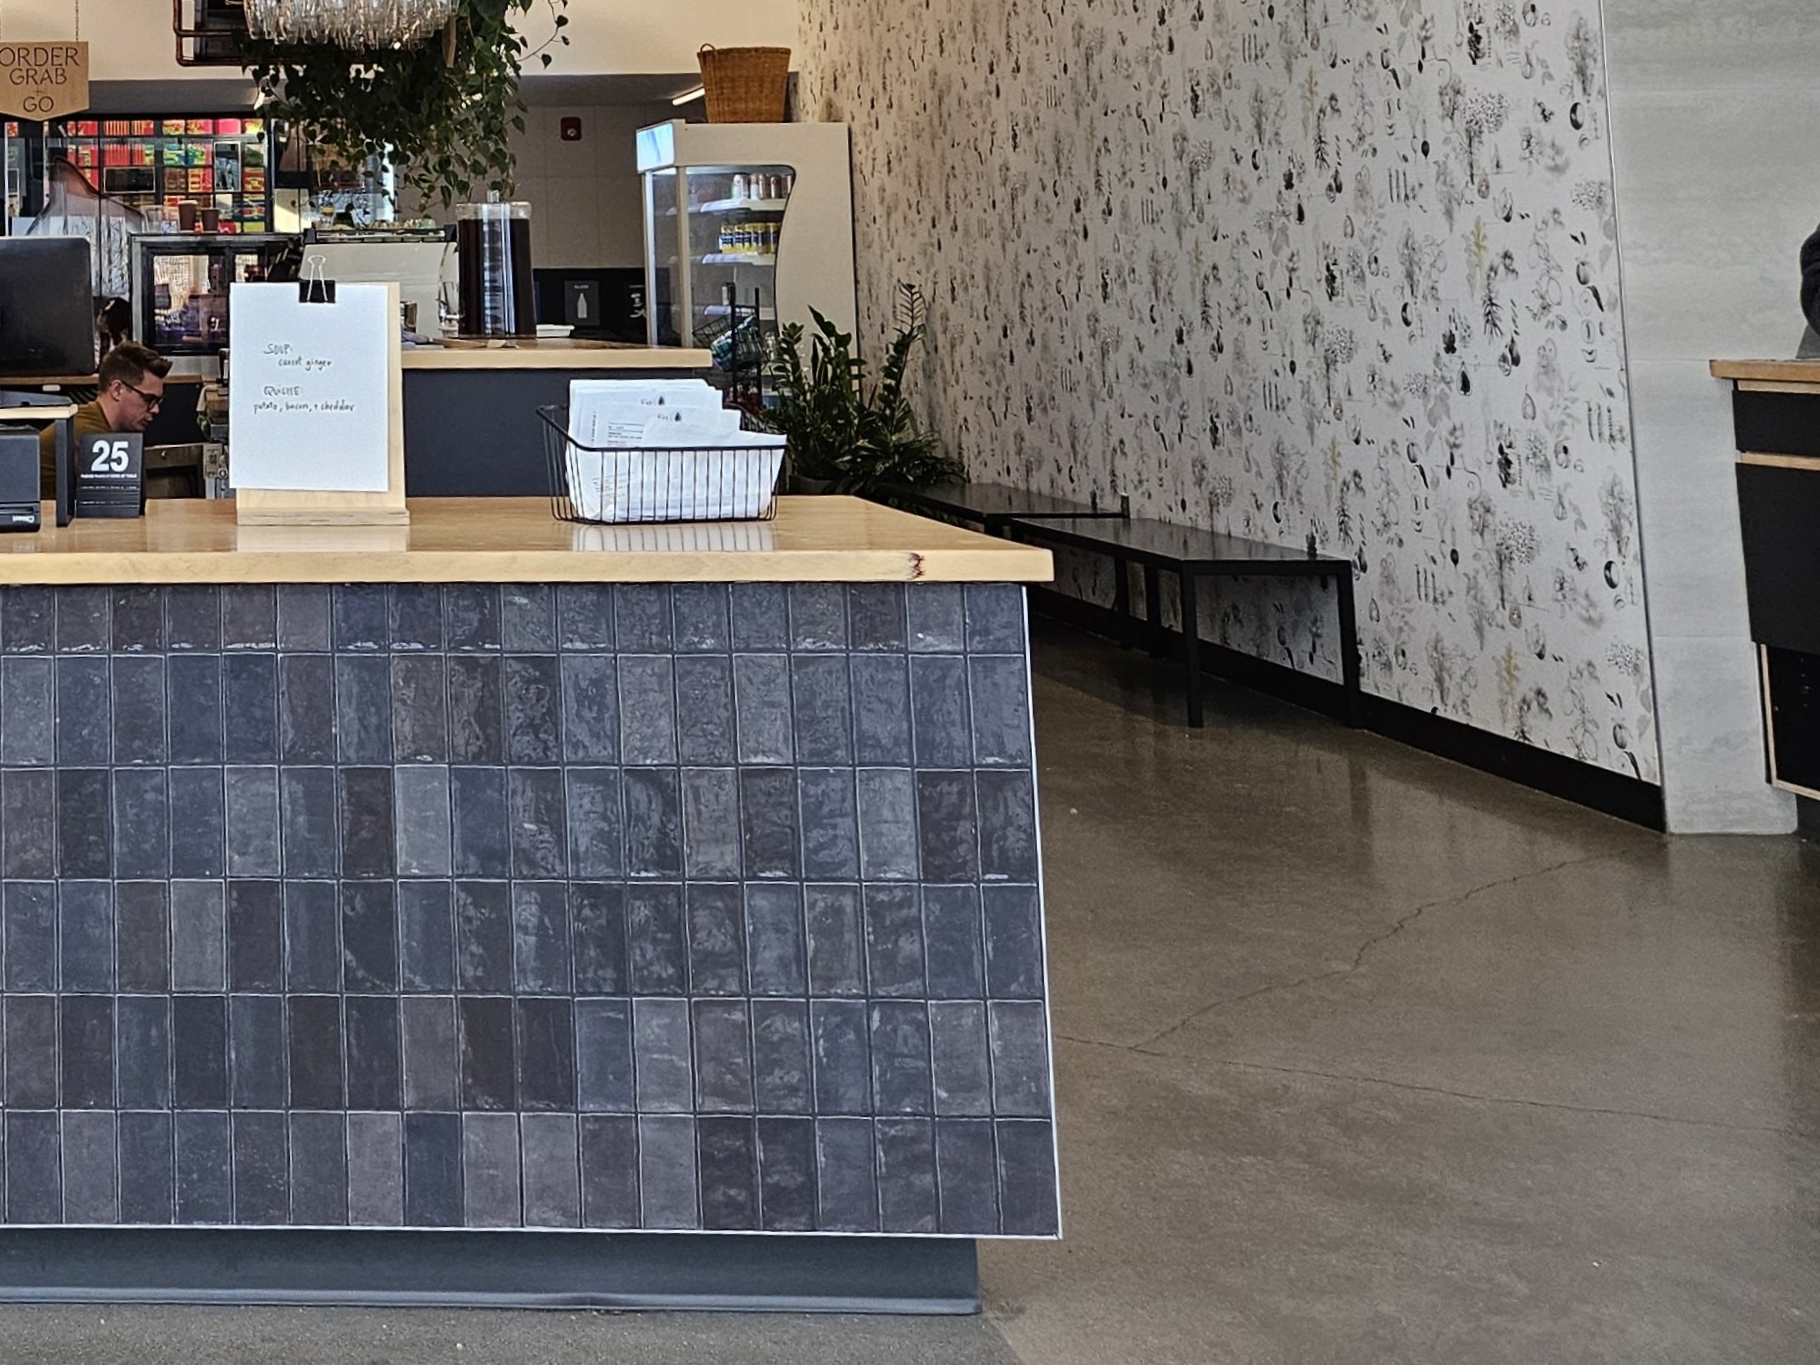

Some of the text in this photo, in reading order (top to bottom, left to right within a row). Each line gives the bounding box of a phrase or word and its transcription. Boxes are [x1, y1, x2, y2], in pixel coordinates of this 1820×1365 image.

[9, 68, 67, 85] GRAB
[23, 96, 54, 112] GO
[305, 358, 332, 371] ginger
[320, 399, 355, 411] cheddar
[91, 440, 129, 472] 25
